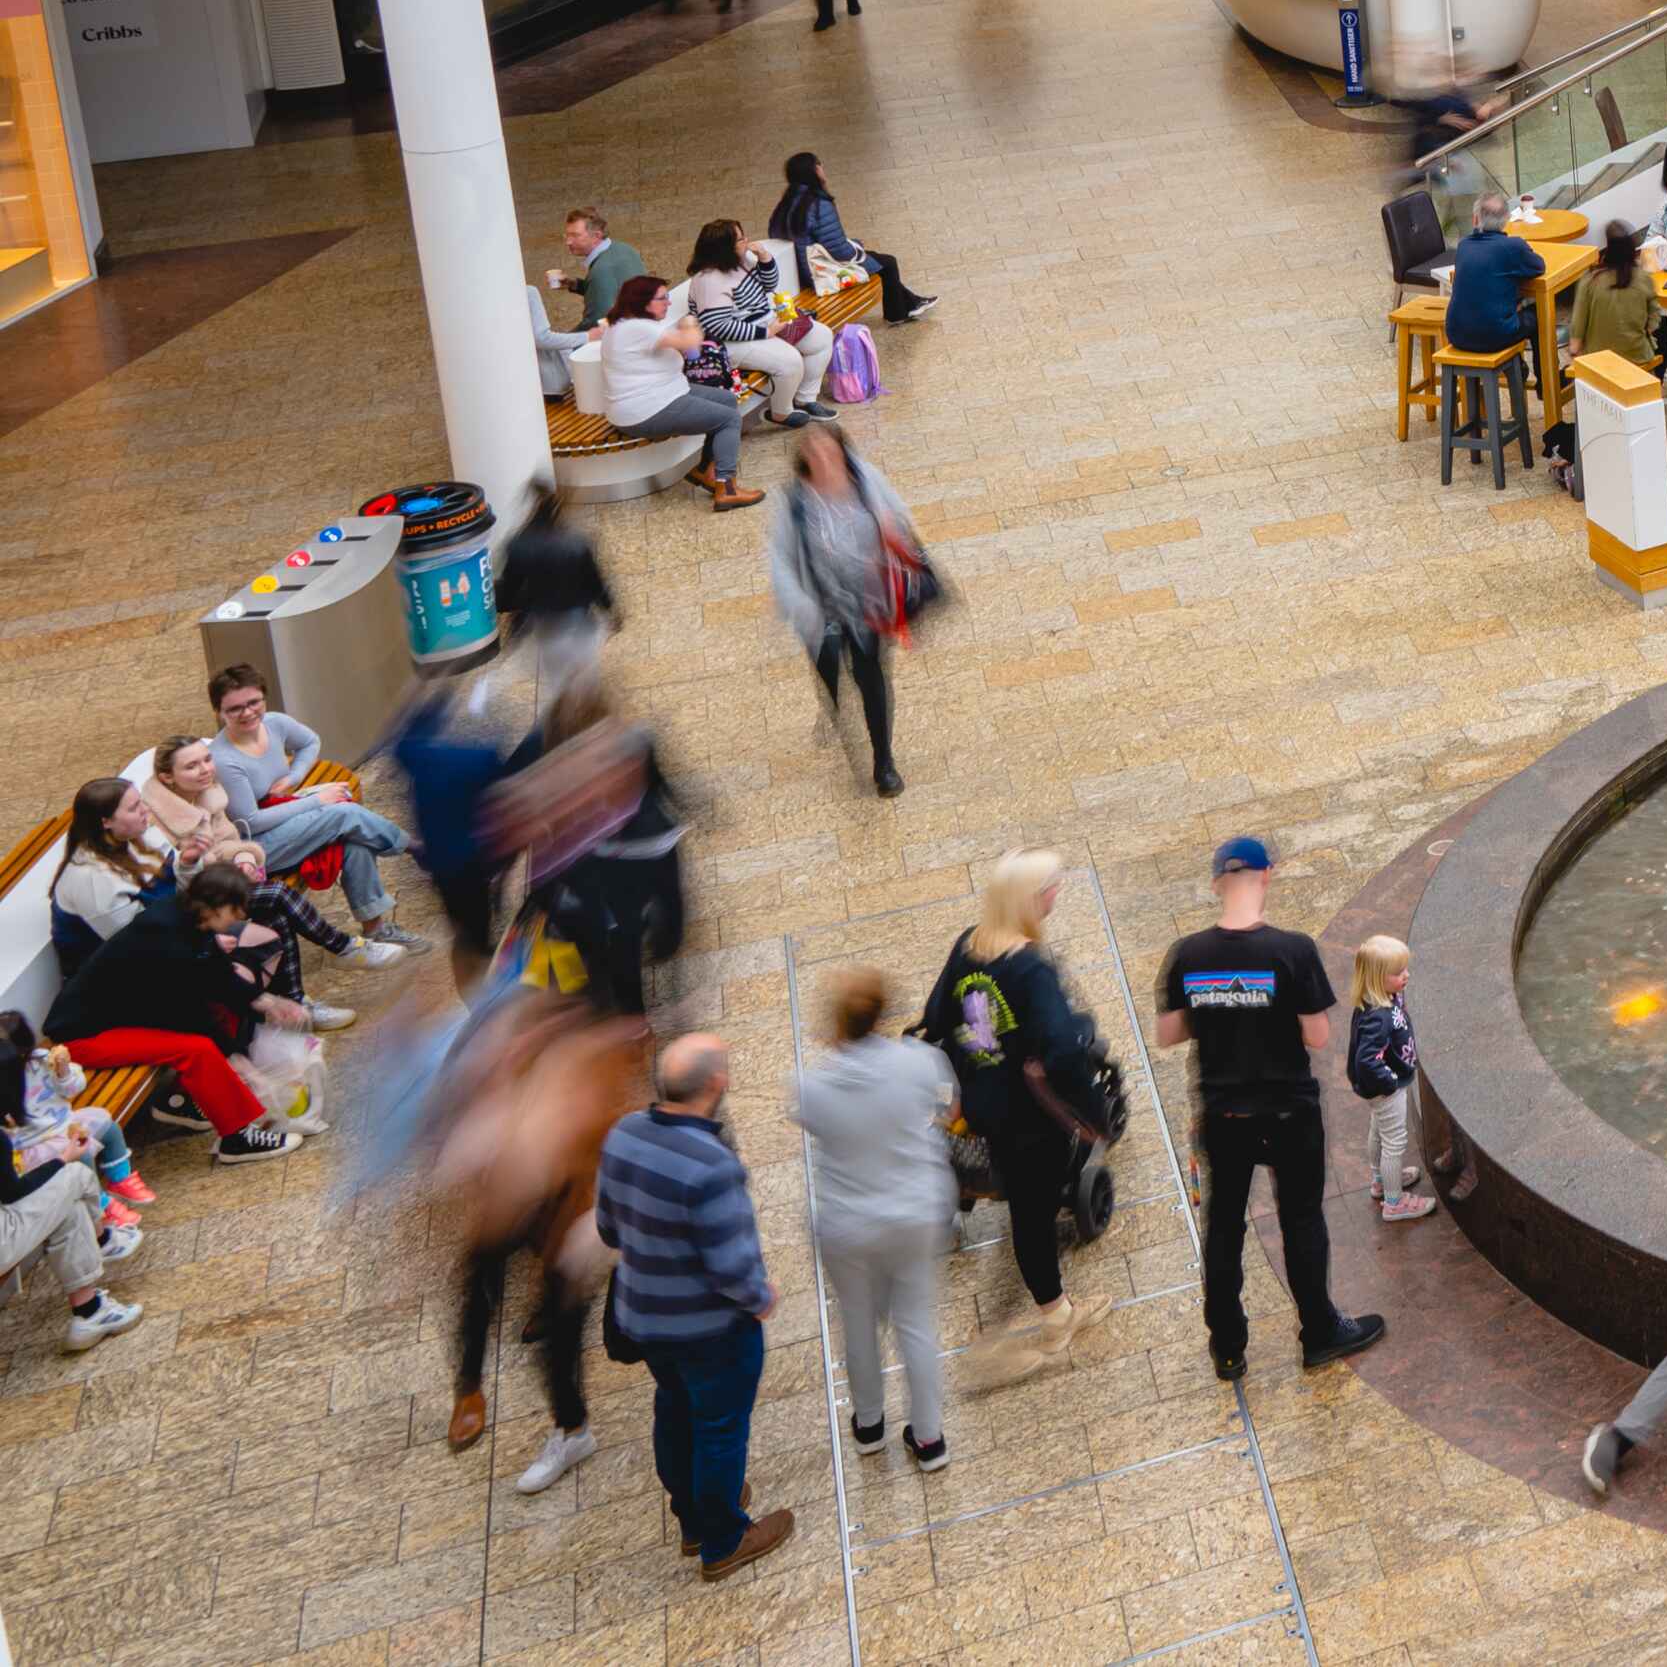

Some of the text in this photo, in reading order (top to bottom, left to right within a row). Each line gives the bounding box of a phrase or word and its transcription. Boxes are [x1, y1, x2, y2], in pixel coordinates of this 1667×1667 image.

[81, 25, 143, 42] Cribbs
[1350, 62, 1359, 83] HAND
[404, 510, 476, 536] UPS RECYCLE
[1190, 989, 1270, 1008] patagonia
